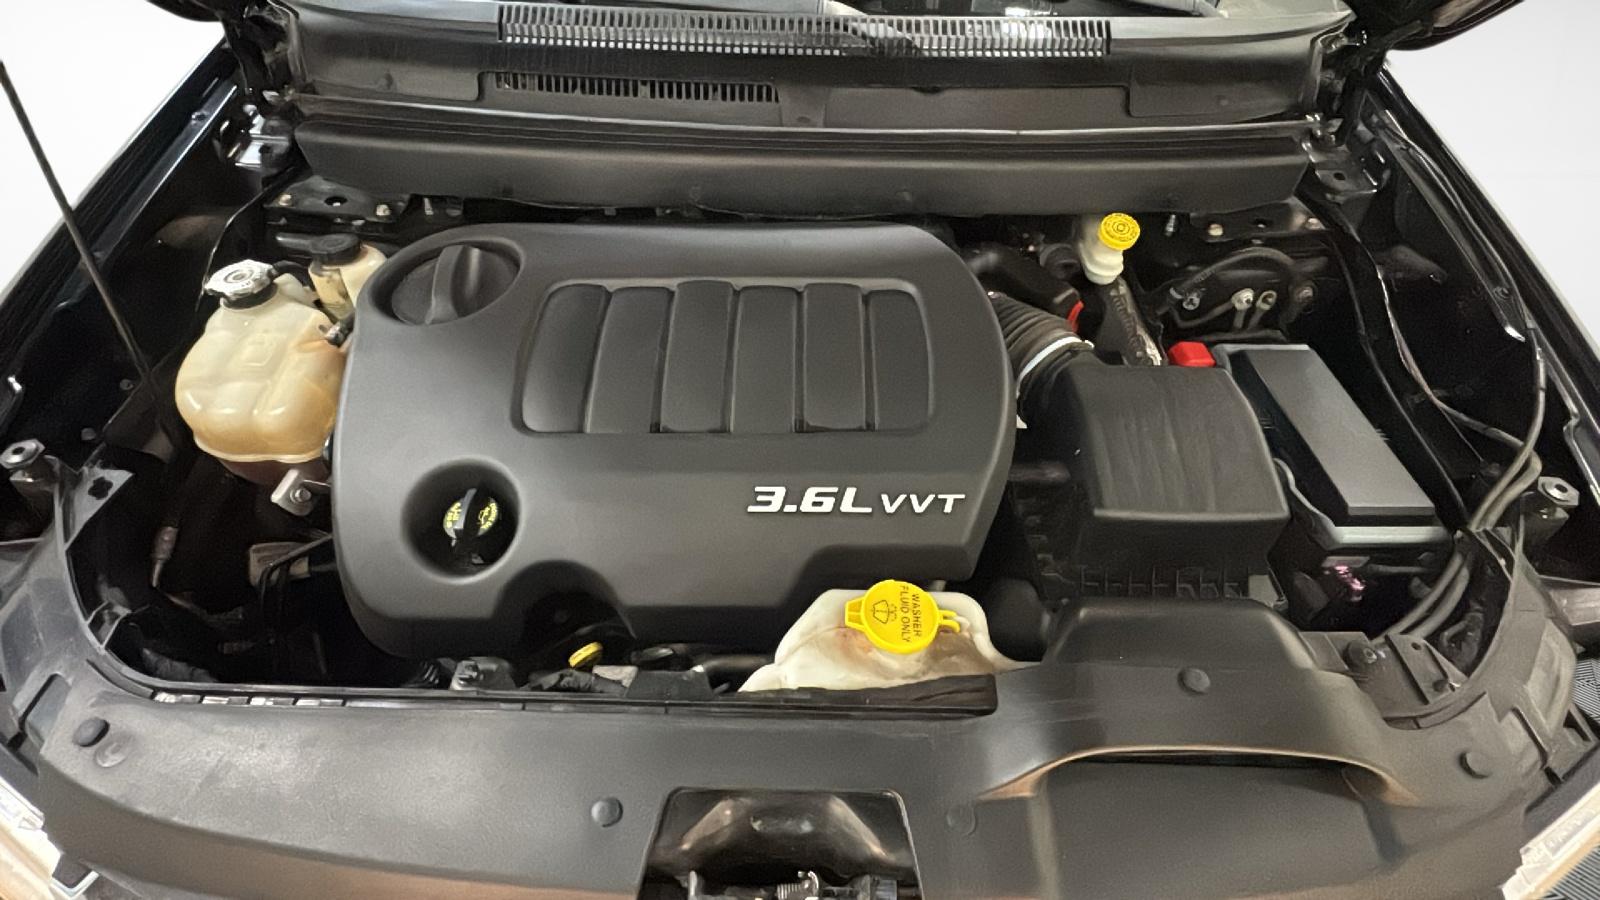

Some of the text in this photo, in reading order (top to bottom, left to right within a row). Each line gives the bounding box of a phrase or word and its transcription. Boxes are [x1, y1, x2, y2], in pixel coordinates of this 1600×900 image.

[747, 486, 966, 514] 3.6L VVT
[900, 585, 912, 642] FLUID ONLY
[912, 593, 922, 638] WASHER
